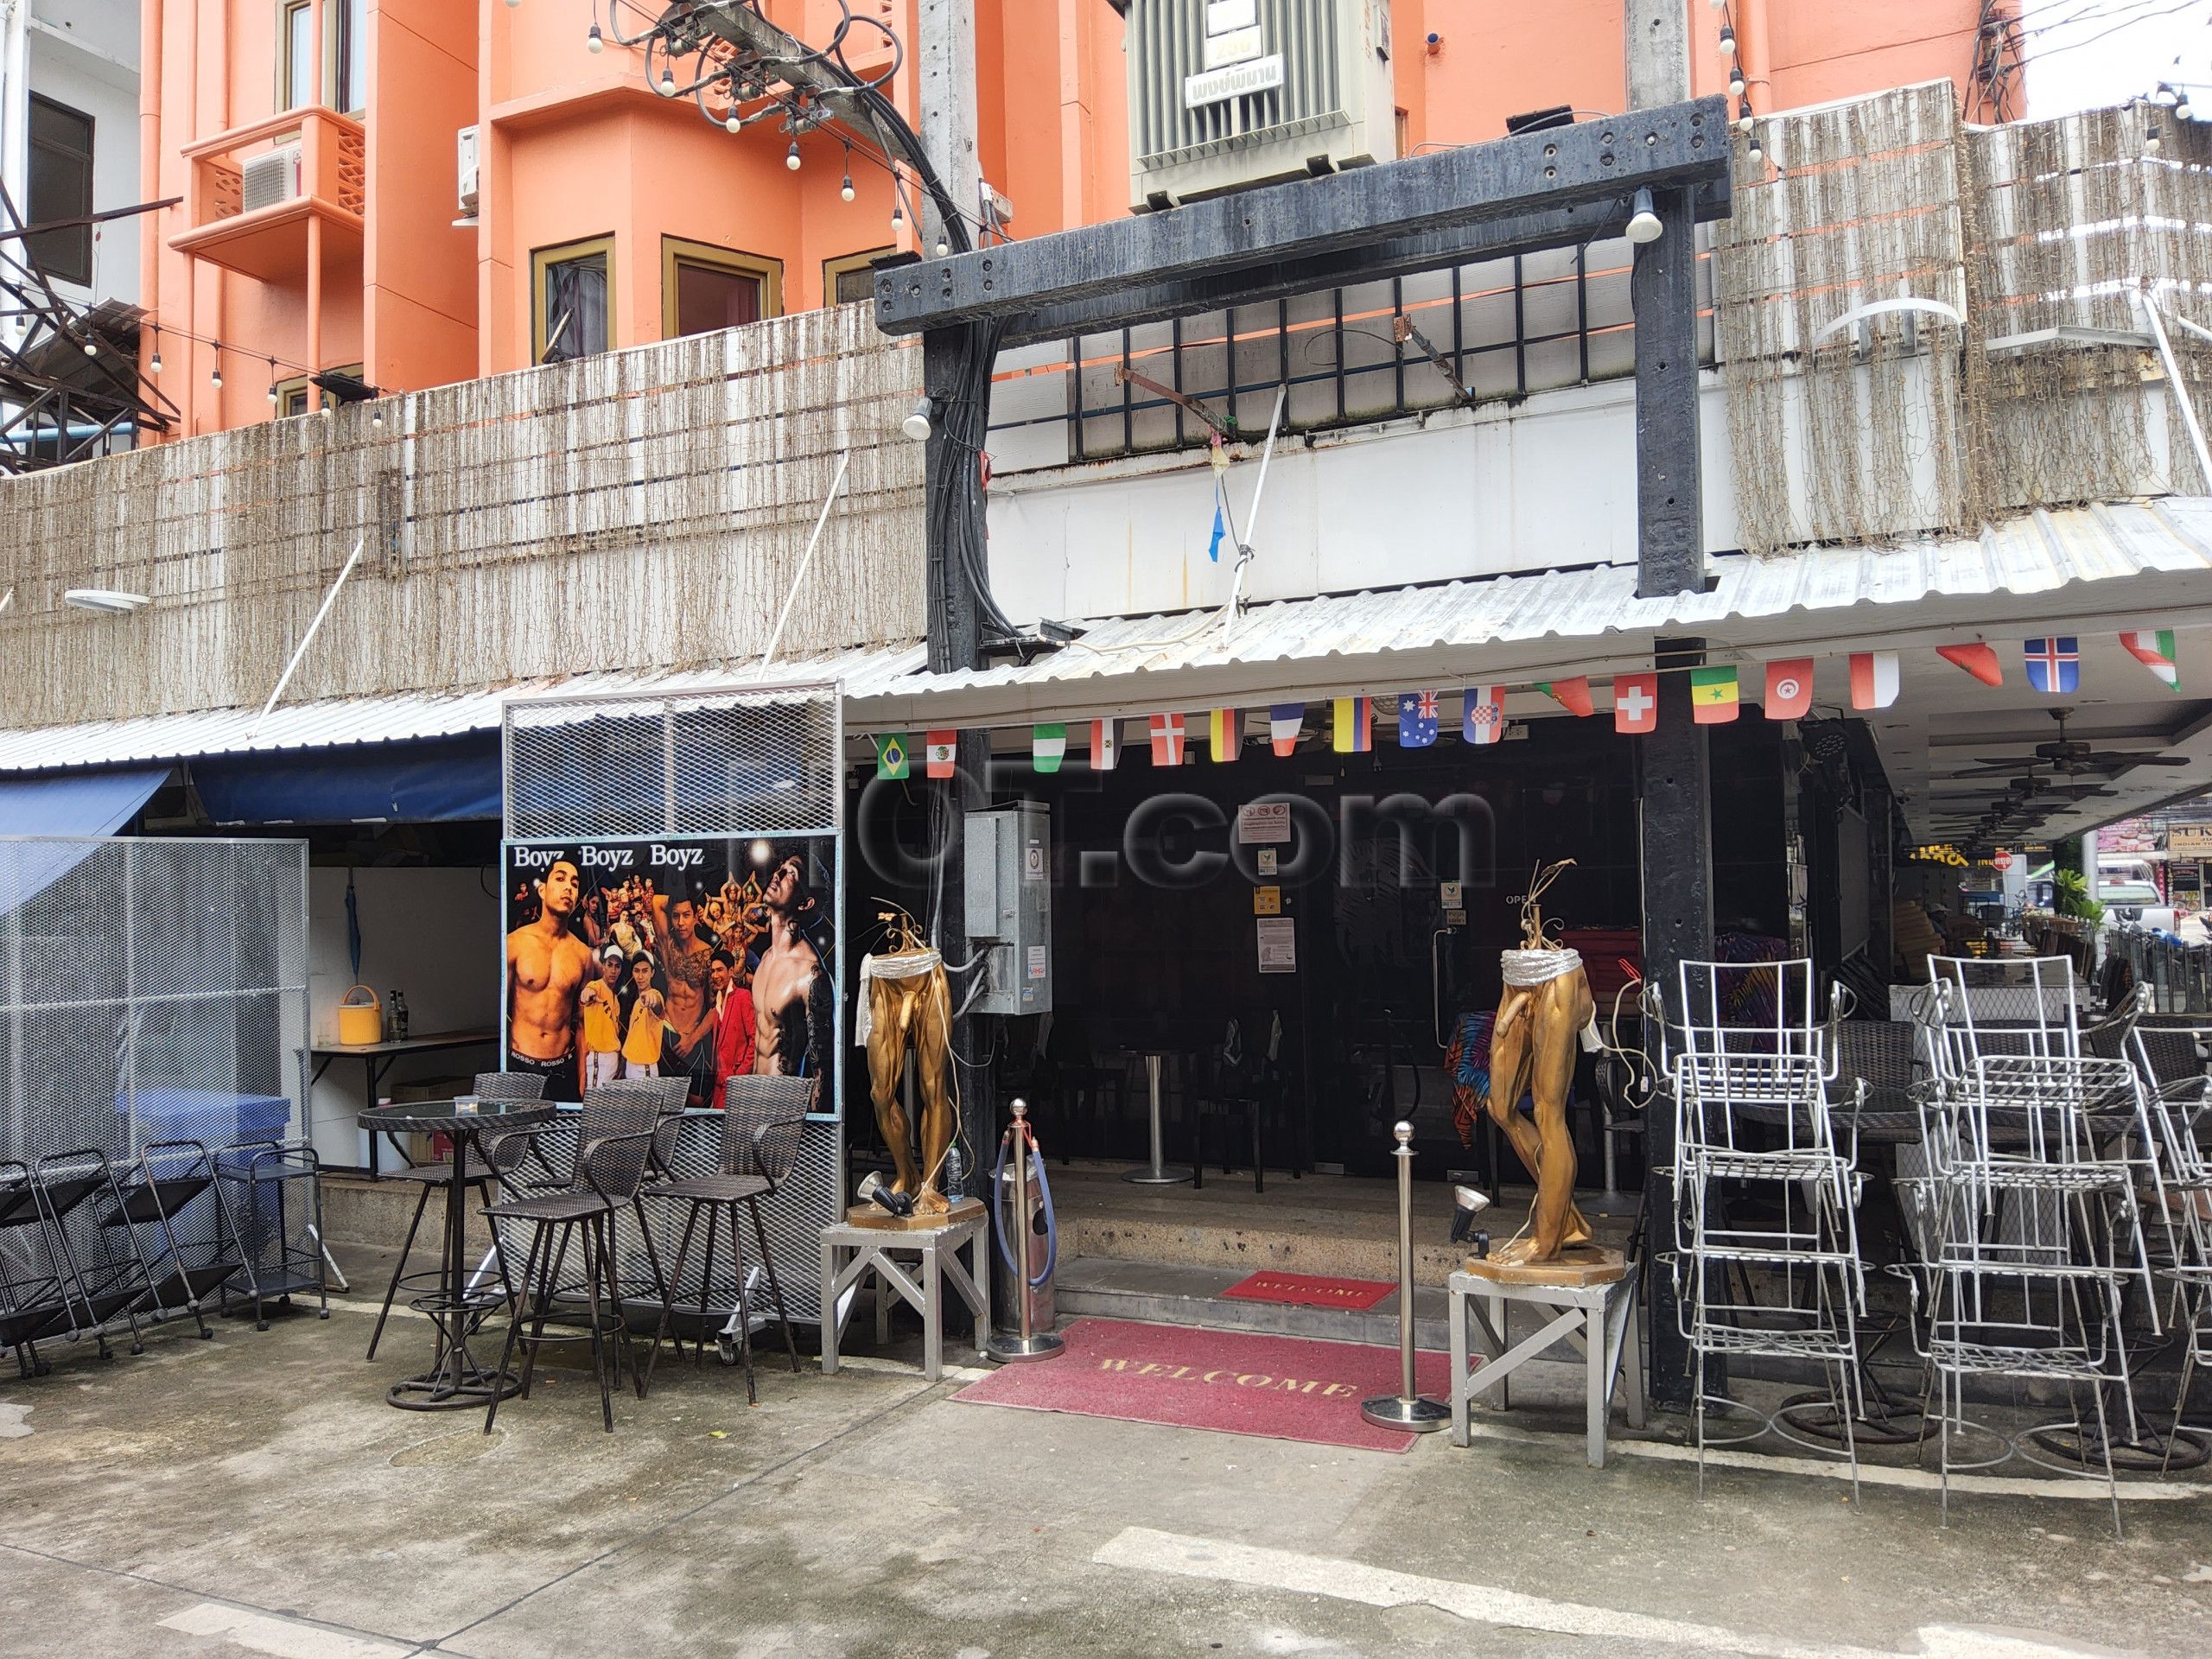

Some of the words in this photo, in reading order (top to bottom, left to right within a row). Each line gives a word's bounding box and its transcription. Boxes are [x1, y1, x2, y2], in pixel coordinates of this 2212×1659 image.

[513, 846, 566, 872] Boyz
[581, 845, 634, 873] Boyz
[650, 844, 704, 872] Boyz
[540, 1058, 565, 1067] ROSSO
[1254, 1280, 1371, 1299] WELCOME
[1100, 1357, 1359, 1398] WELCOME
